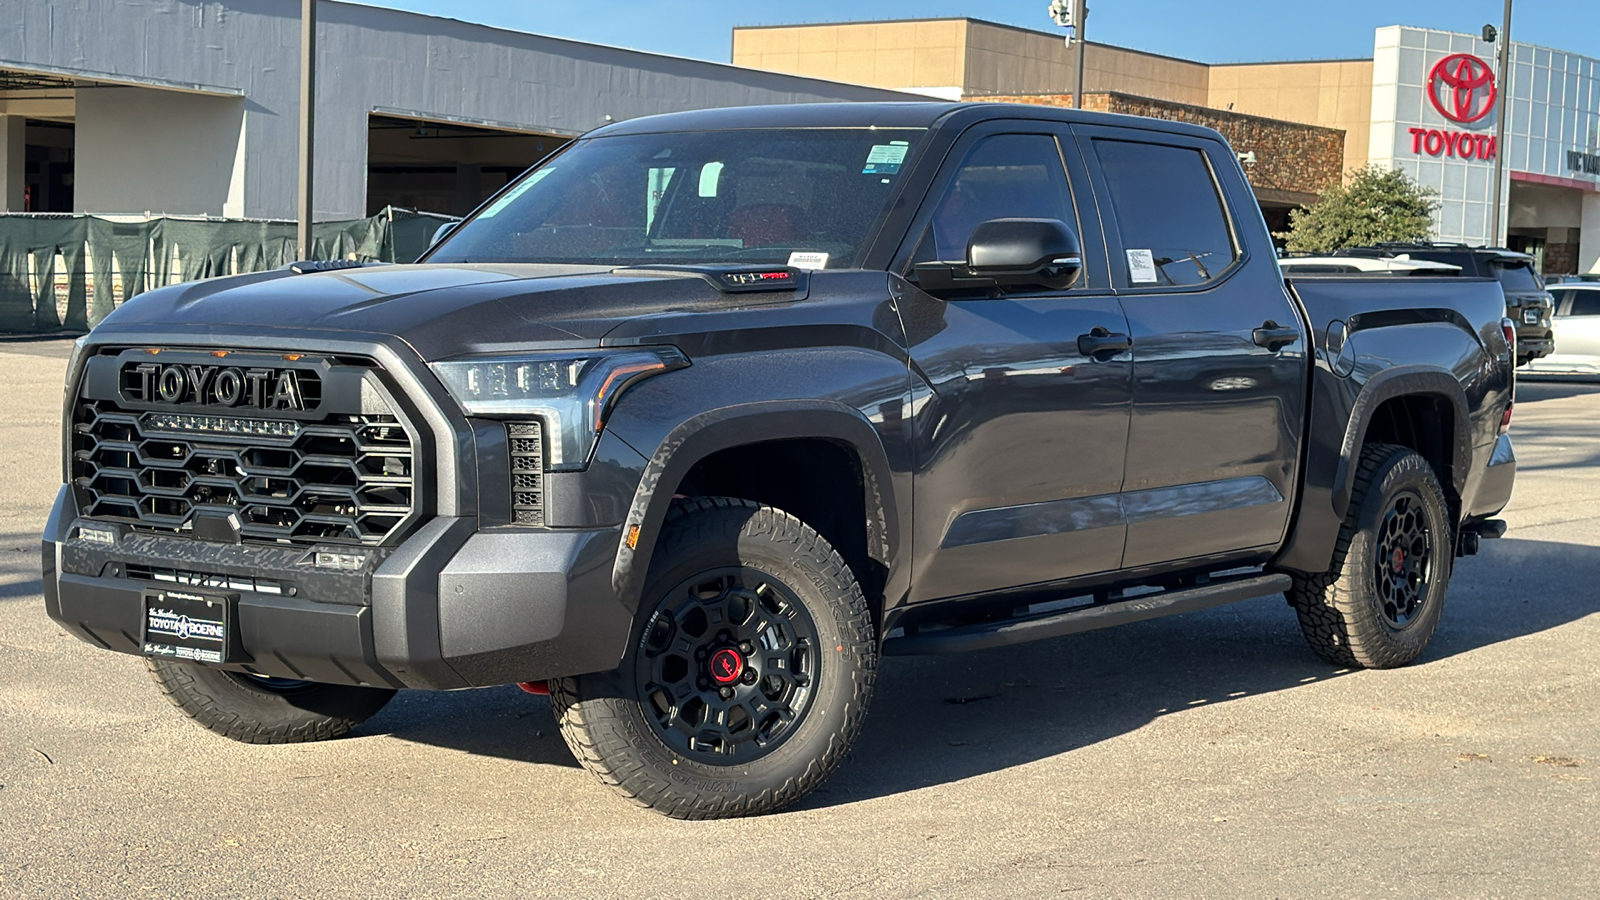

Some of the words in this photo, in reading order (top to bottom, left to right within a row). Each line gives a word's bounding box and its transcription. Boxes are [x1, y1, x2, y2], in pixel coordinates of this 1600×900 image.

[1408, 127, 1497, 160] TOYOTA
[136, 363, 305, 411] TOYOTA
[148, 616, 178, 631] TOYOTA
[190, 622, 224, 637] BOERNE
